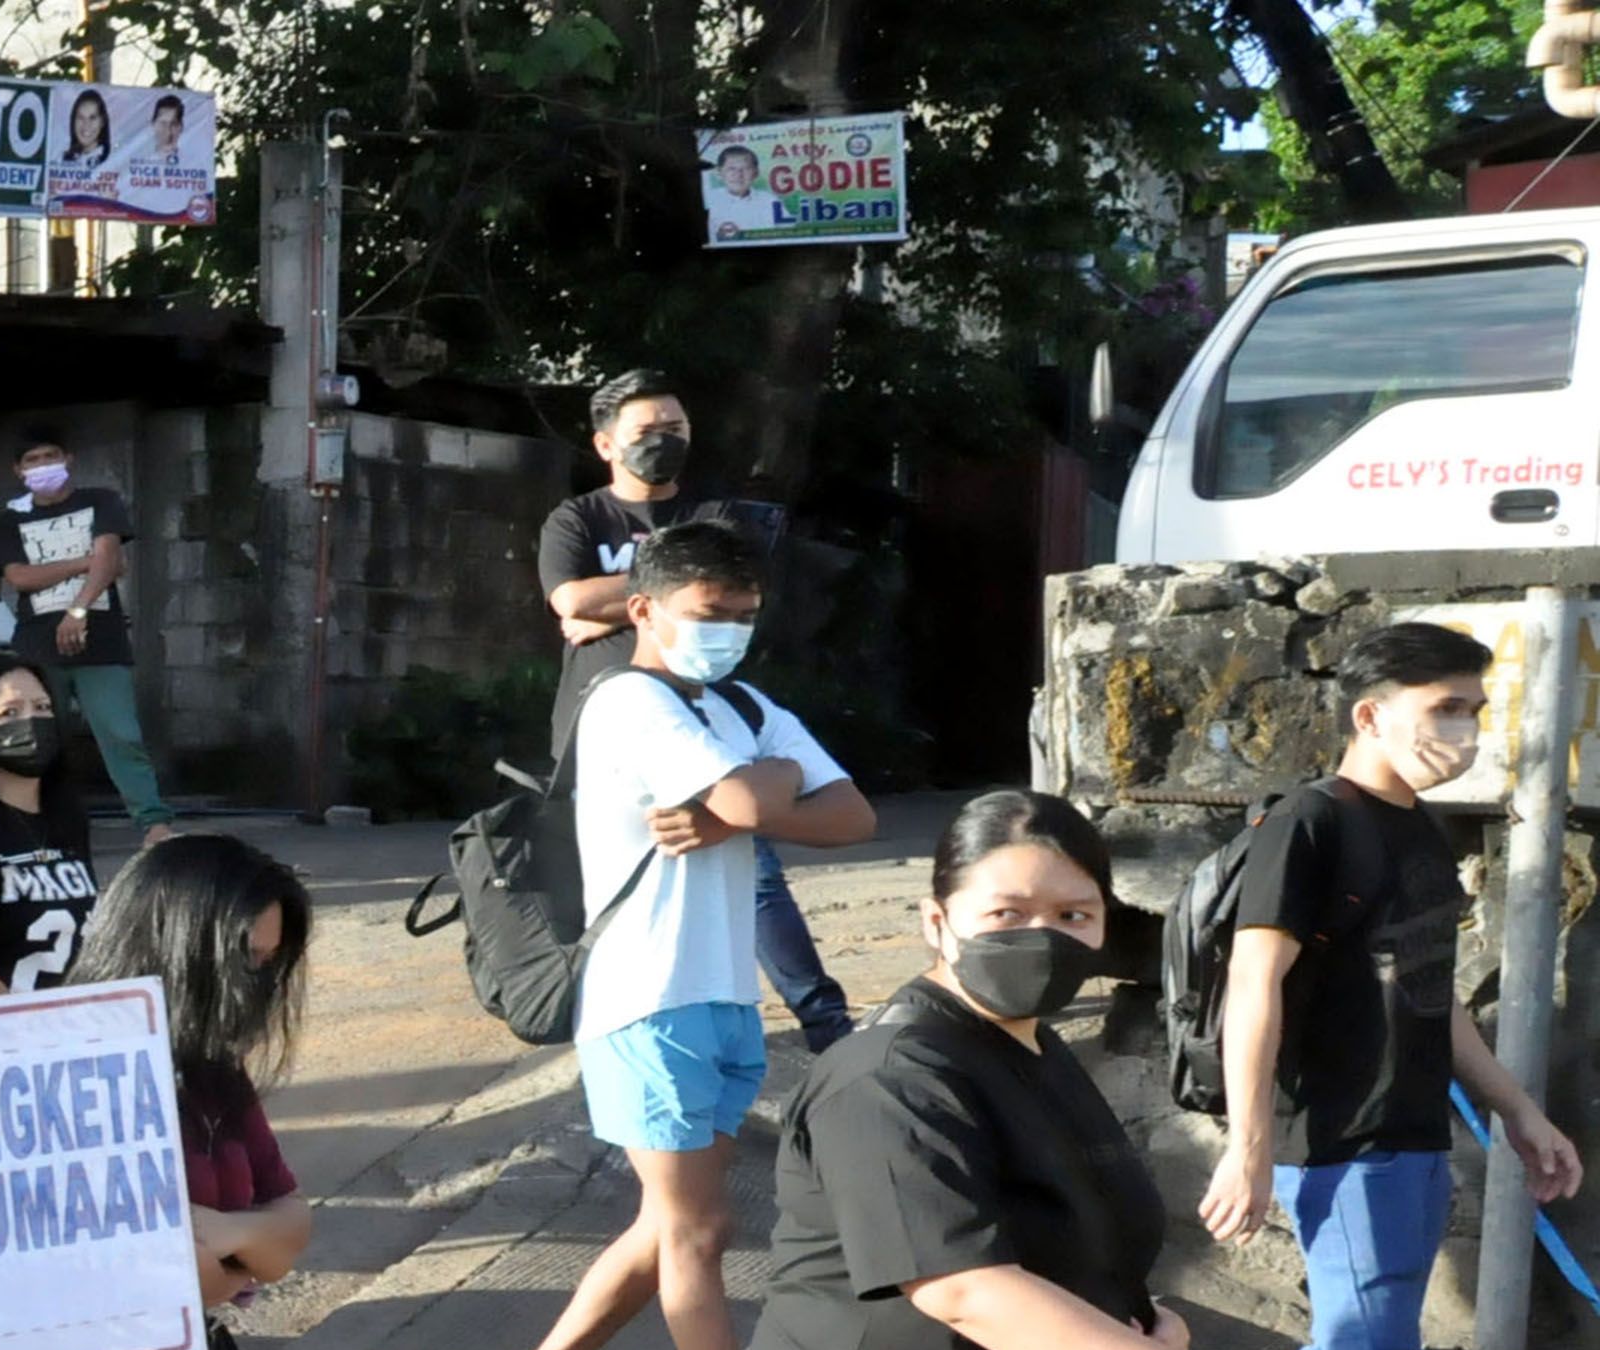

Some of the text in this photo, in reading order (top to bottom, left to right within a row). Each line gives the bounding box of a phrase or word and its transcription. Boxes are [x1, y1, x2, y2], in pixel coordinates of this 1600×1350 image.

[771, 144, 833, 159] Atty.
[49, 169, 119, 182] MAYOR JOY
[129, 166, 207, 179] VICE MAYOR
[769, 158, 893, 195] GODIE
[130, 177, 207, 191] GIAN SOTTO
[772, 198, 894, 225] Liban
[1348, 456, 1584, 489] CELY'S Trading
